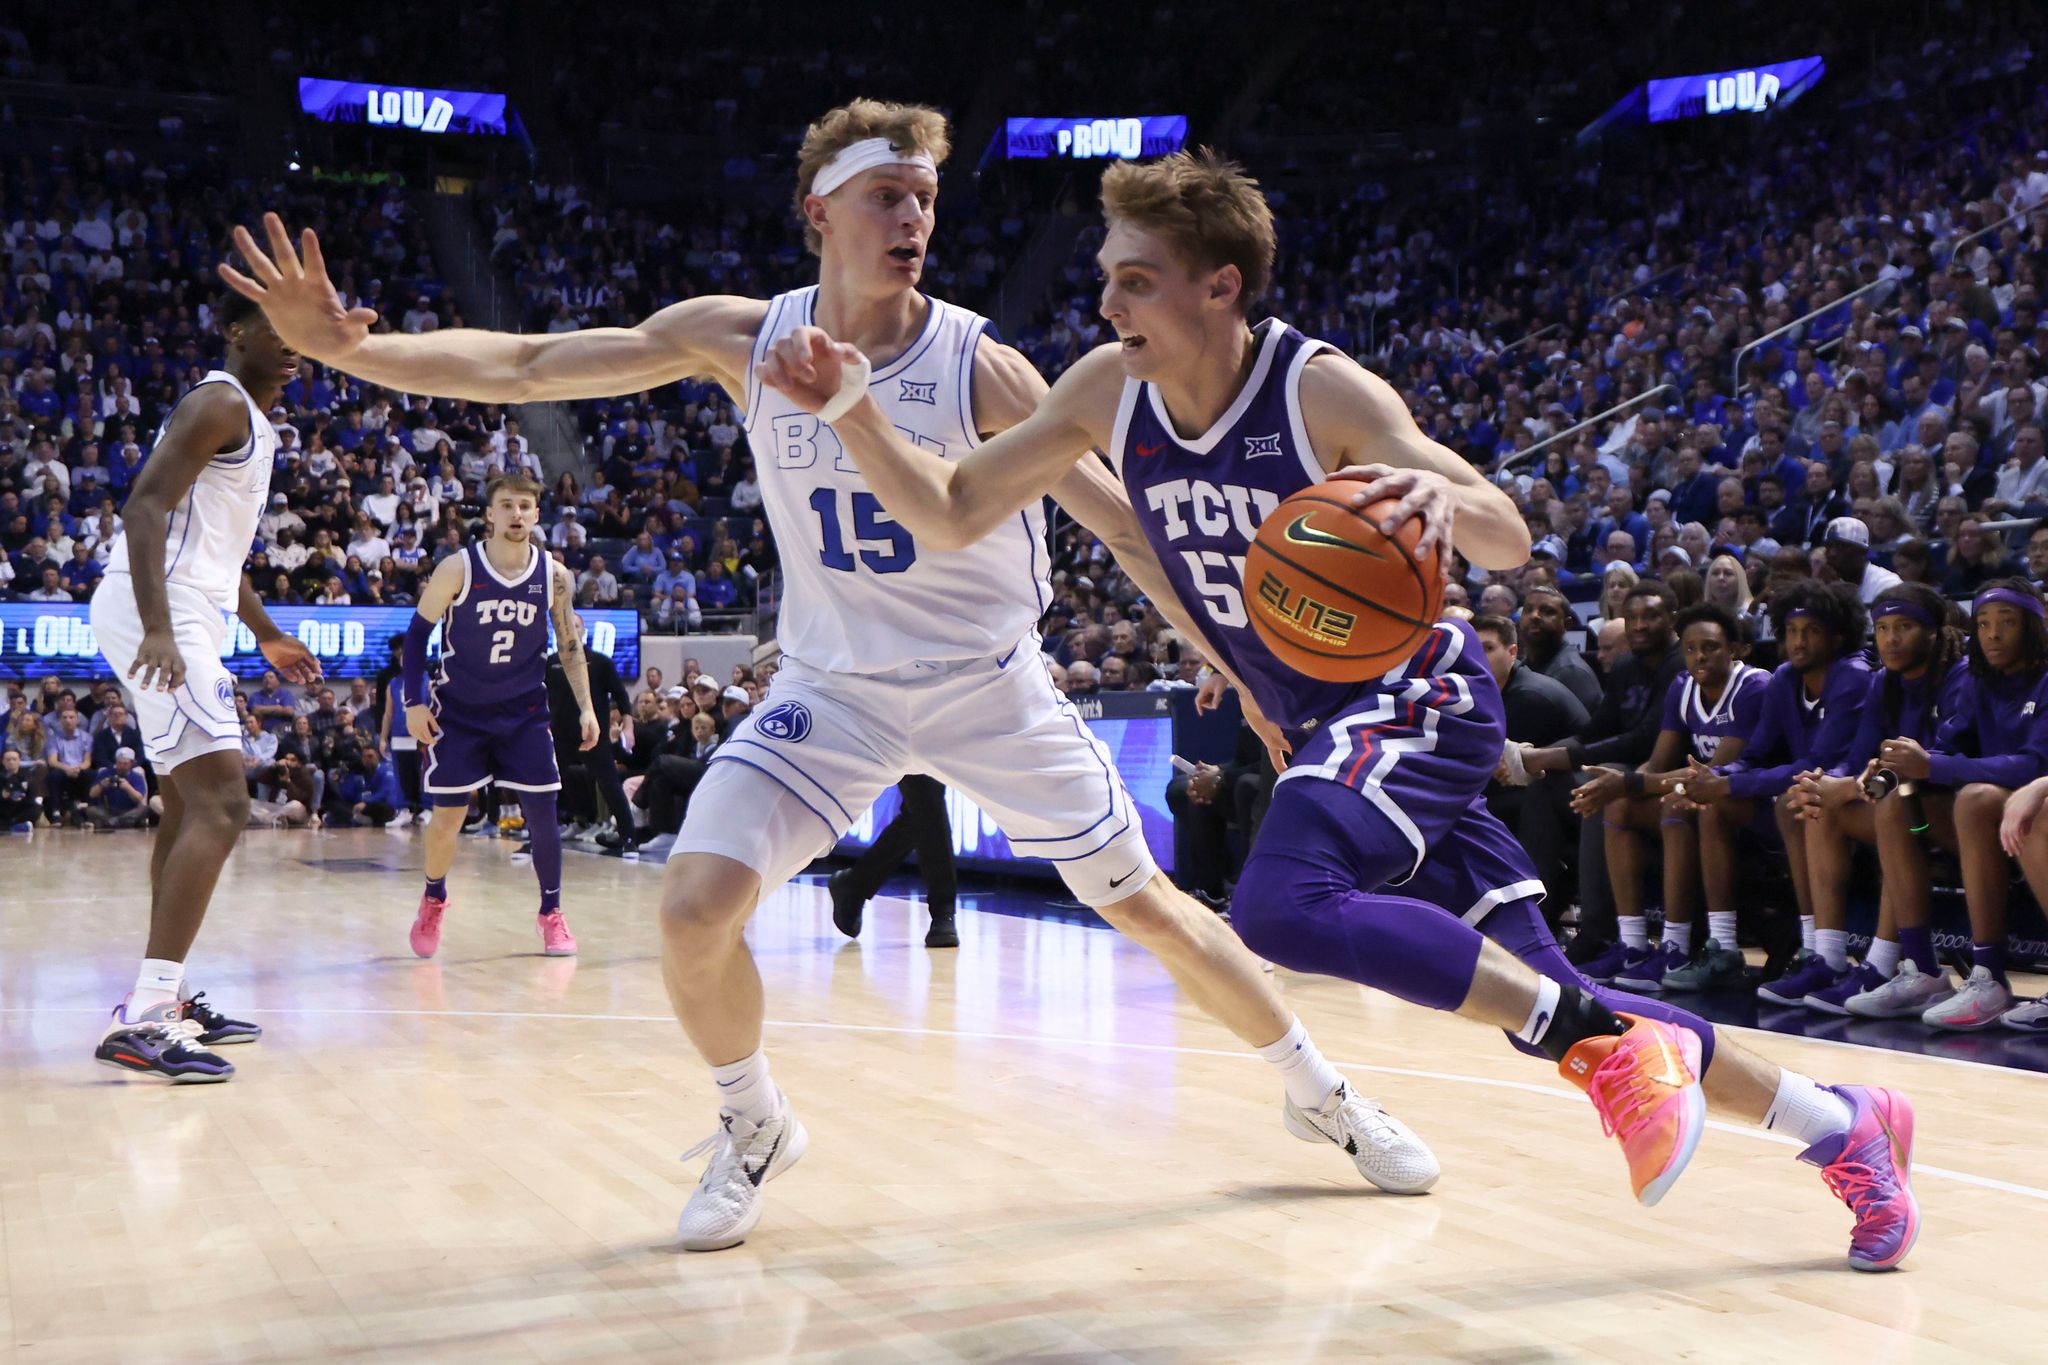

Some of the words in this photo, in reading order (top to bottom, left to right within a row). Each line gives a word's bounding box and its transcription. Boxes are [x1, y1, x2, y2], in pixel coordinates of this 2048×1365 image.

[368, 90, 454, 133] LOUD
[1706, 71, 1780, 115] LOUD
[1058, 118, 1142, 159] PROVO
[809, 487, 916, 574] 15
[1144, 478, 1280, 543] TCU
[1179, 551, 1249, 629] 5
[476, 599, 538, 627] TCU
[286, 619, 364, 657] OUD
[489, 630, 515, 664] 2
